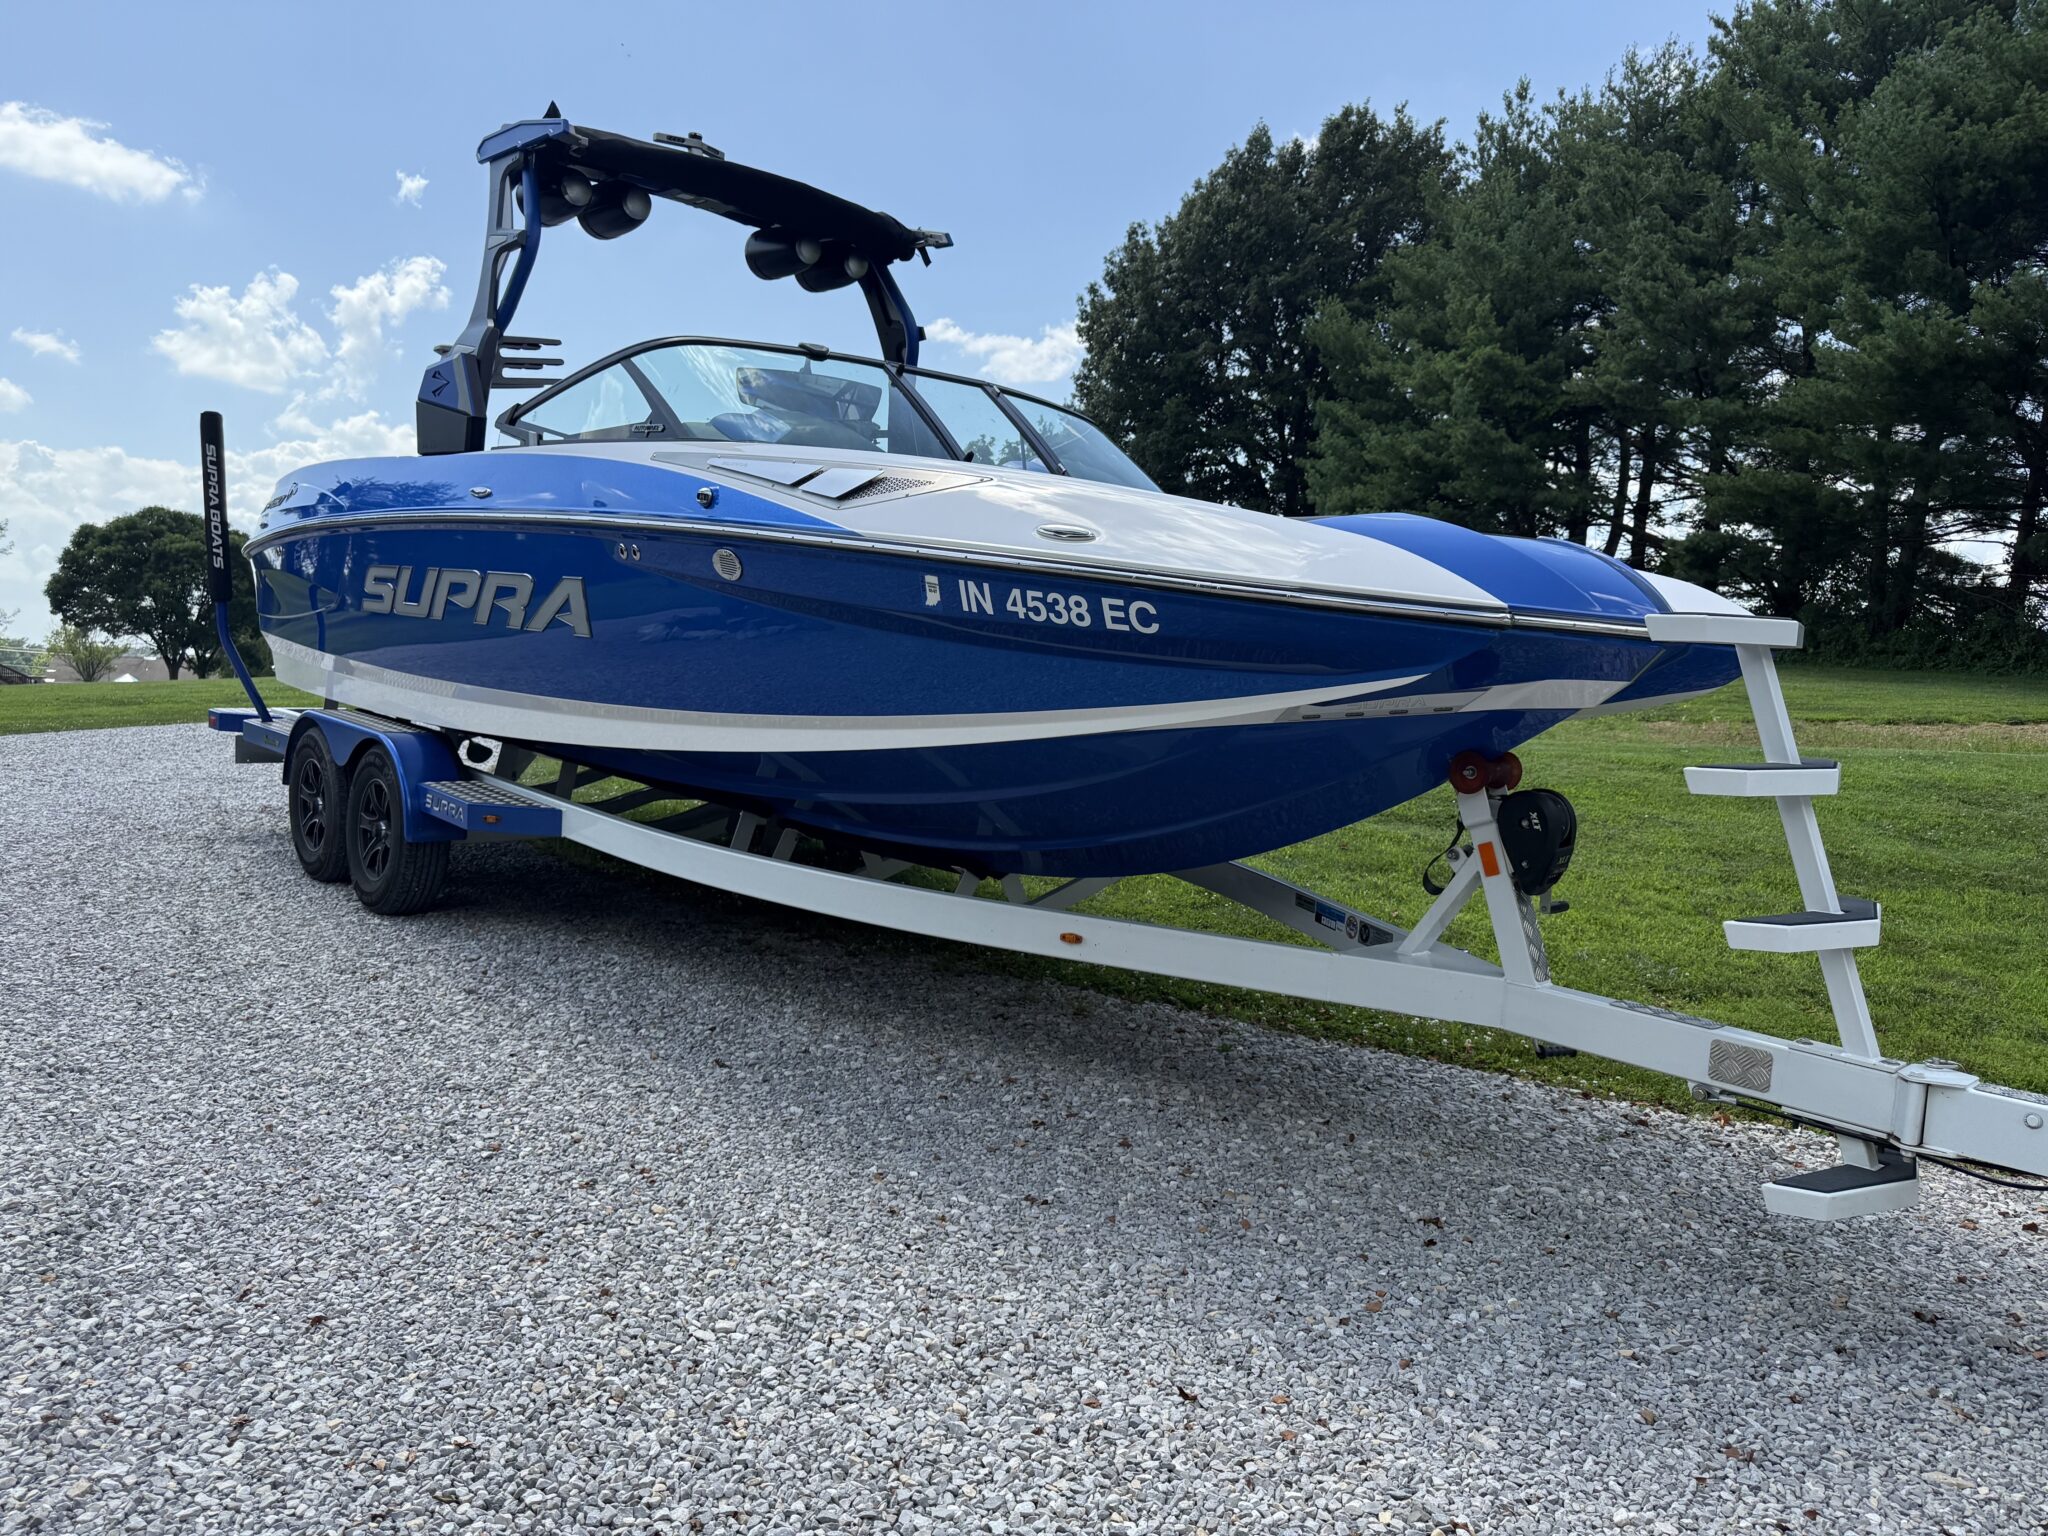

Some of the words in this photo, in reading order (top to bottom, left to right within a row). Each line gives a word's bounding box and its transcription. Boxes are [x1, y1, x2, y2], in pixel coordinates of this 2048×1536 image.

[205, 443, 220, 507] SUPRA
[210, 508, 225, 570] BOATS
[362, 565, 593, 638] SUPRA
[958, 579, 994, 616] IN
[1006, 588, 1092, 628] 4538
[1101, 597, 1160, 635] EC
[425, 793, 464, 823] SUPRA
[1529, 811, 1542, 832] XLT
